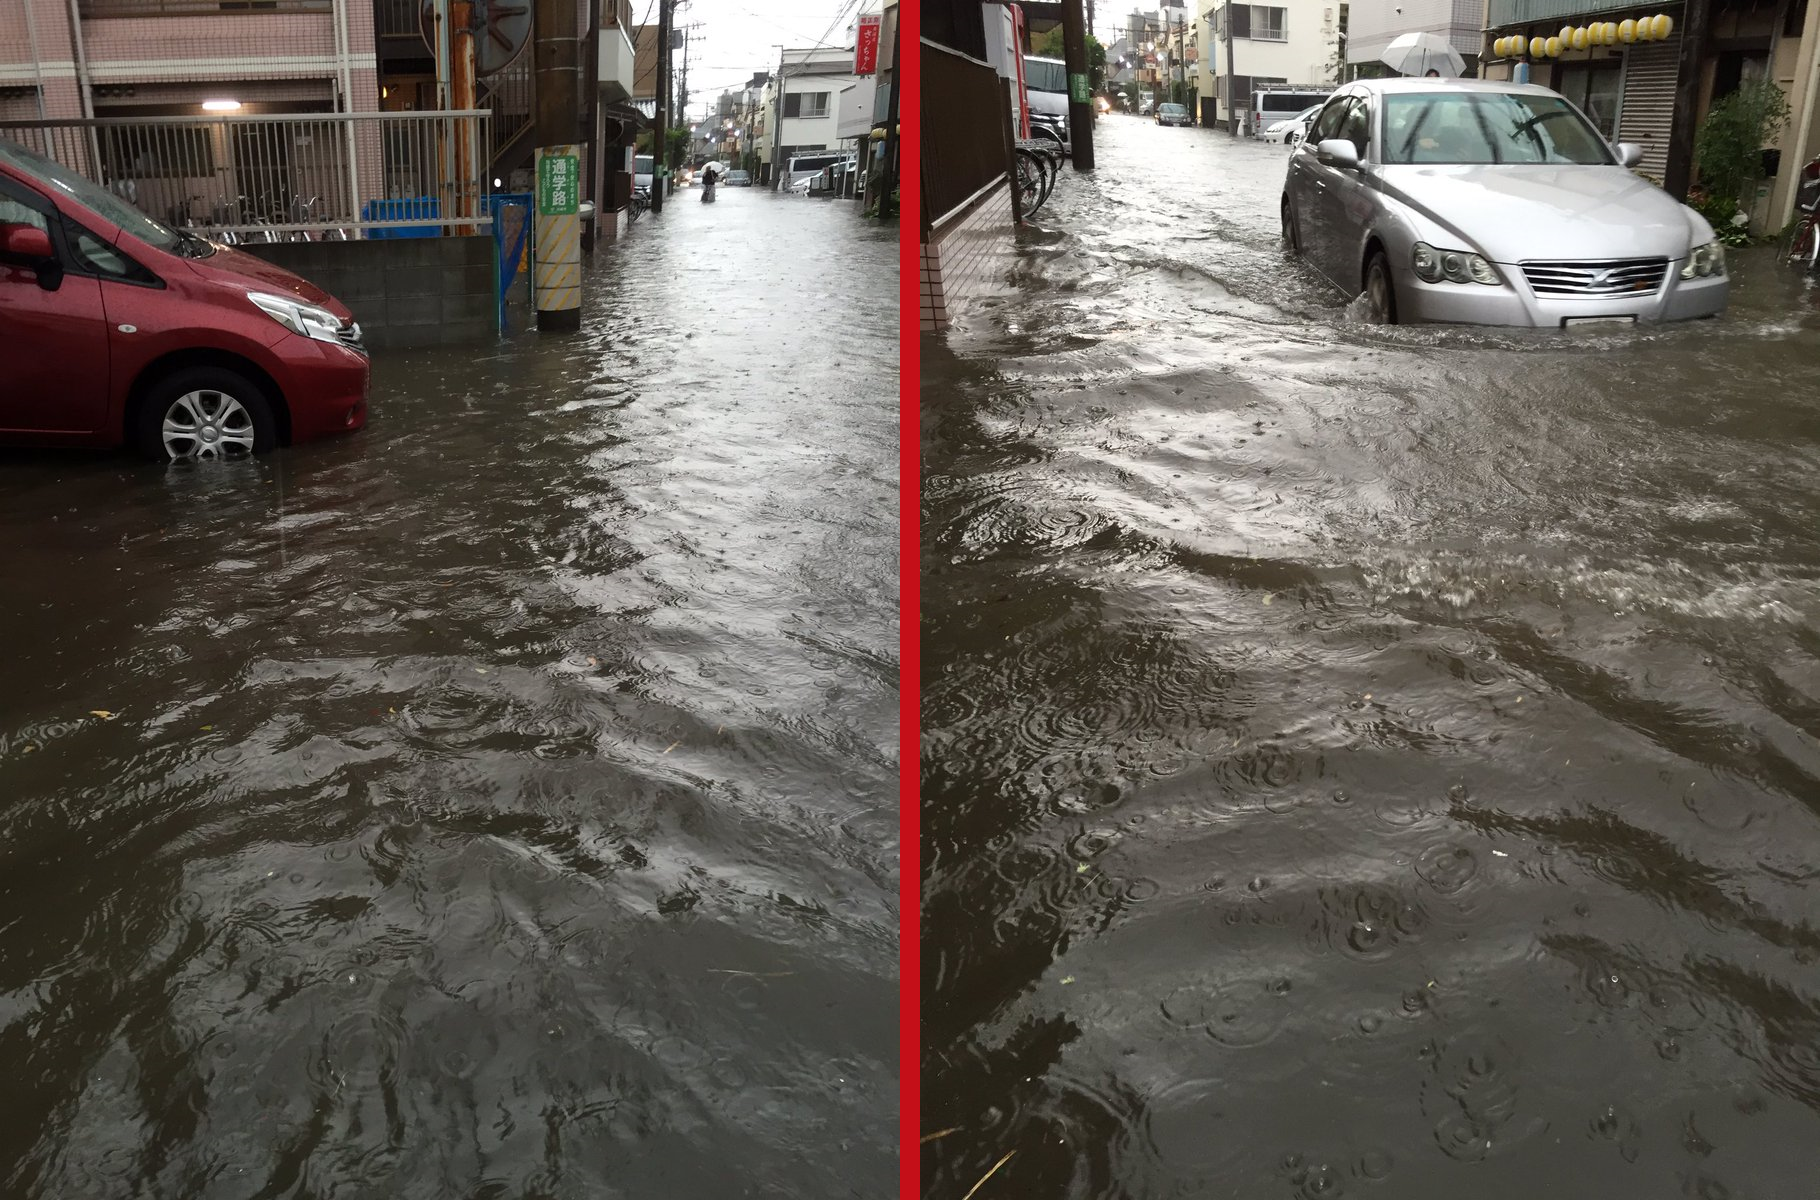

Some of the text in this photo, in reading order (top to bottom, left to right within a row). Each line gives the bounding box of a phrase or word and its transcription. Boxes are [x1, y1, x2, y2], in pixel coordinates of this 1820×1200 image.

[861, 30, 872, 71] さっちゃん
[552, 158, 567, 206] 通学路
